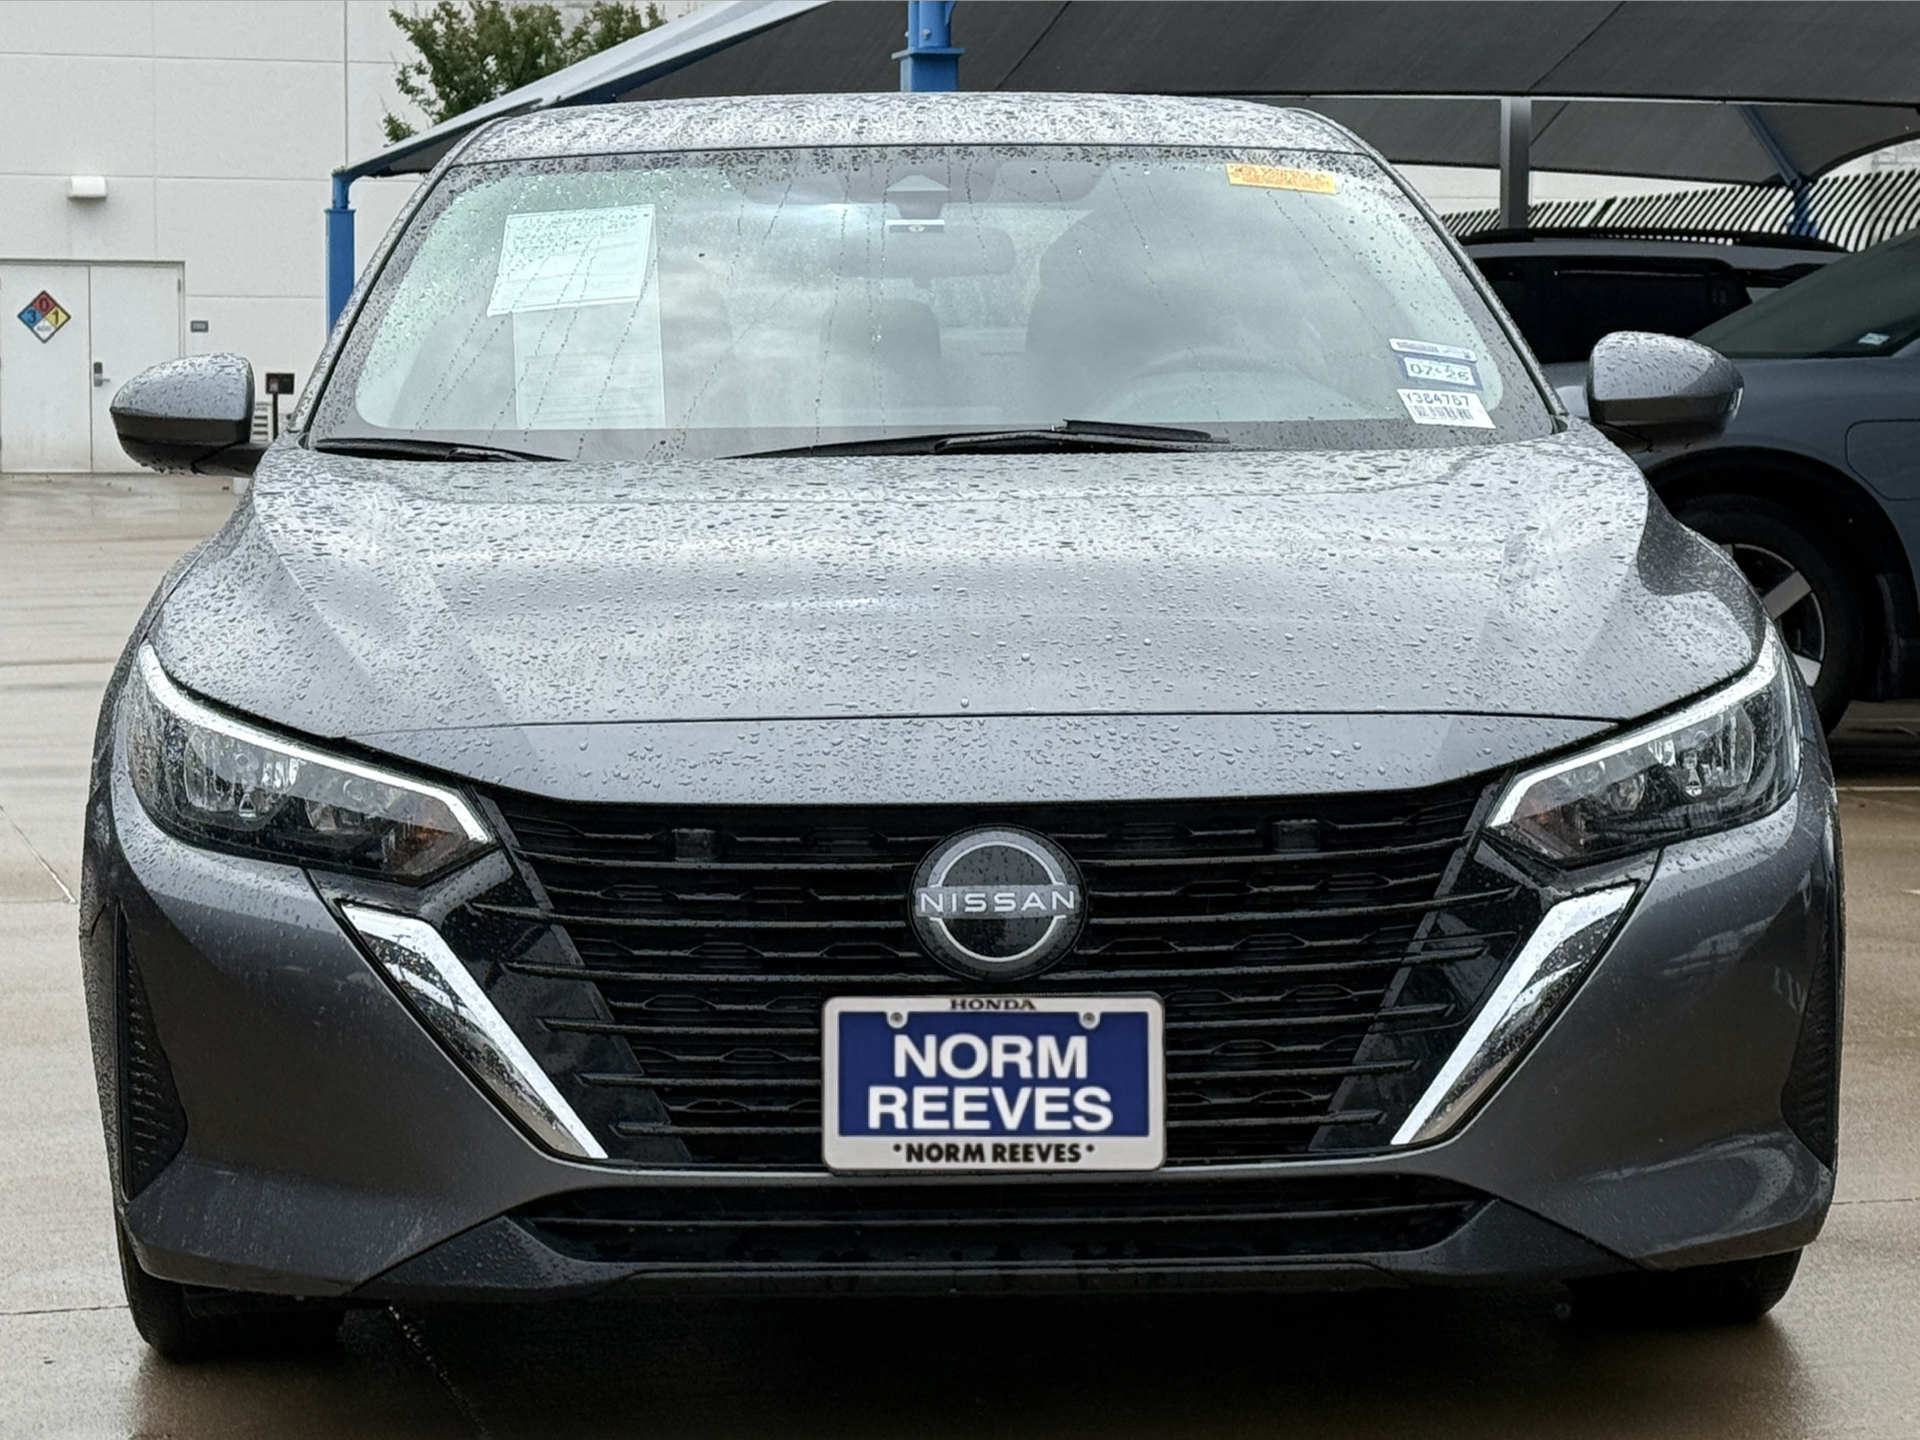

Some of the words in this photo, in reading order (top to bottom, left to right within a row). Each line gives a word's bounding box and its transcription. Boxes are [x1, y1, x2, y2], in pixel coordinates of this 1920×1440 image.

[39, 297, 50, 311] 0
[26, 309, 37, 324] 3
[51, 309, 60, 325] 1
[920, 890, 1075, 913] NISSAN
[949, 999, 1037, 1010] HONDA
[894, 1033, 1088, 1079] NORM
[868, 1085, 1114, 1131] REEVES
[905, 1143, 985, 1163] NORM
[992, 1143, 1082, 1163] REEVES
